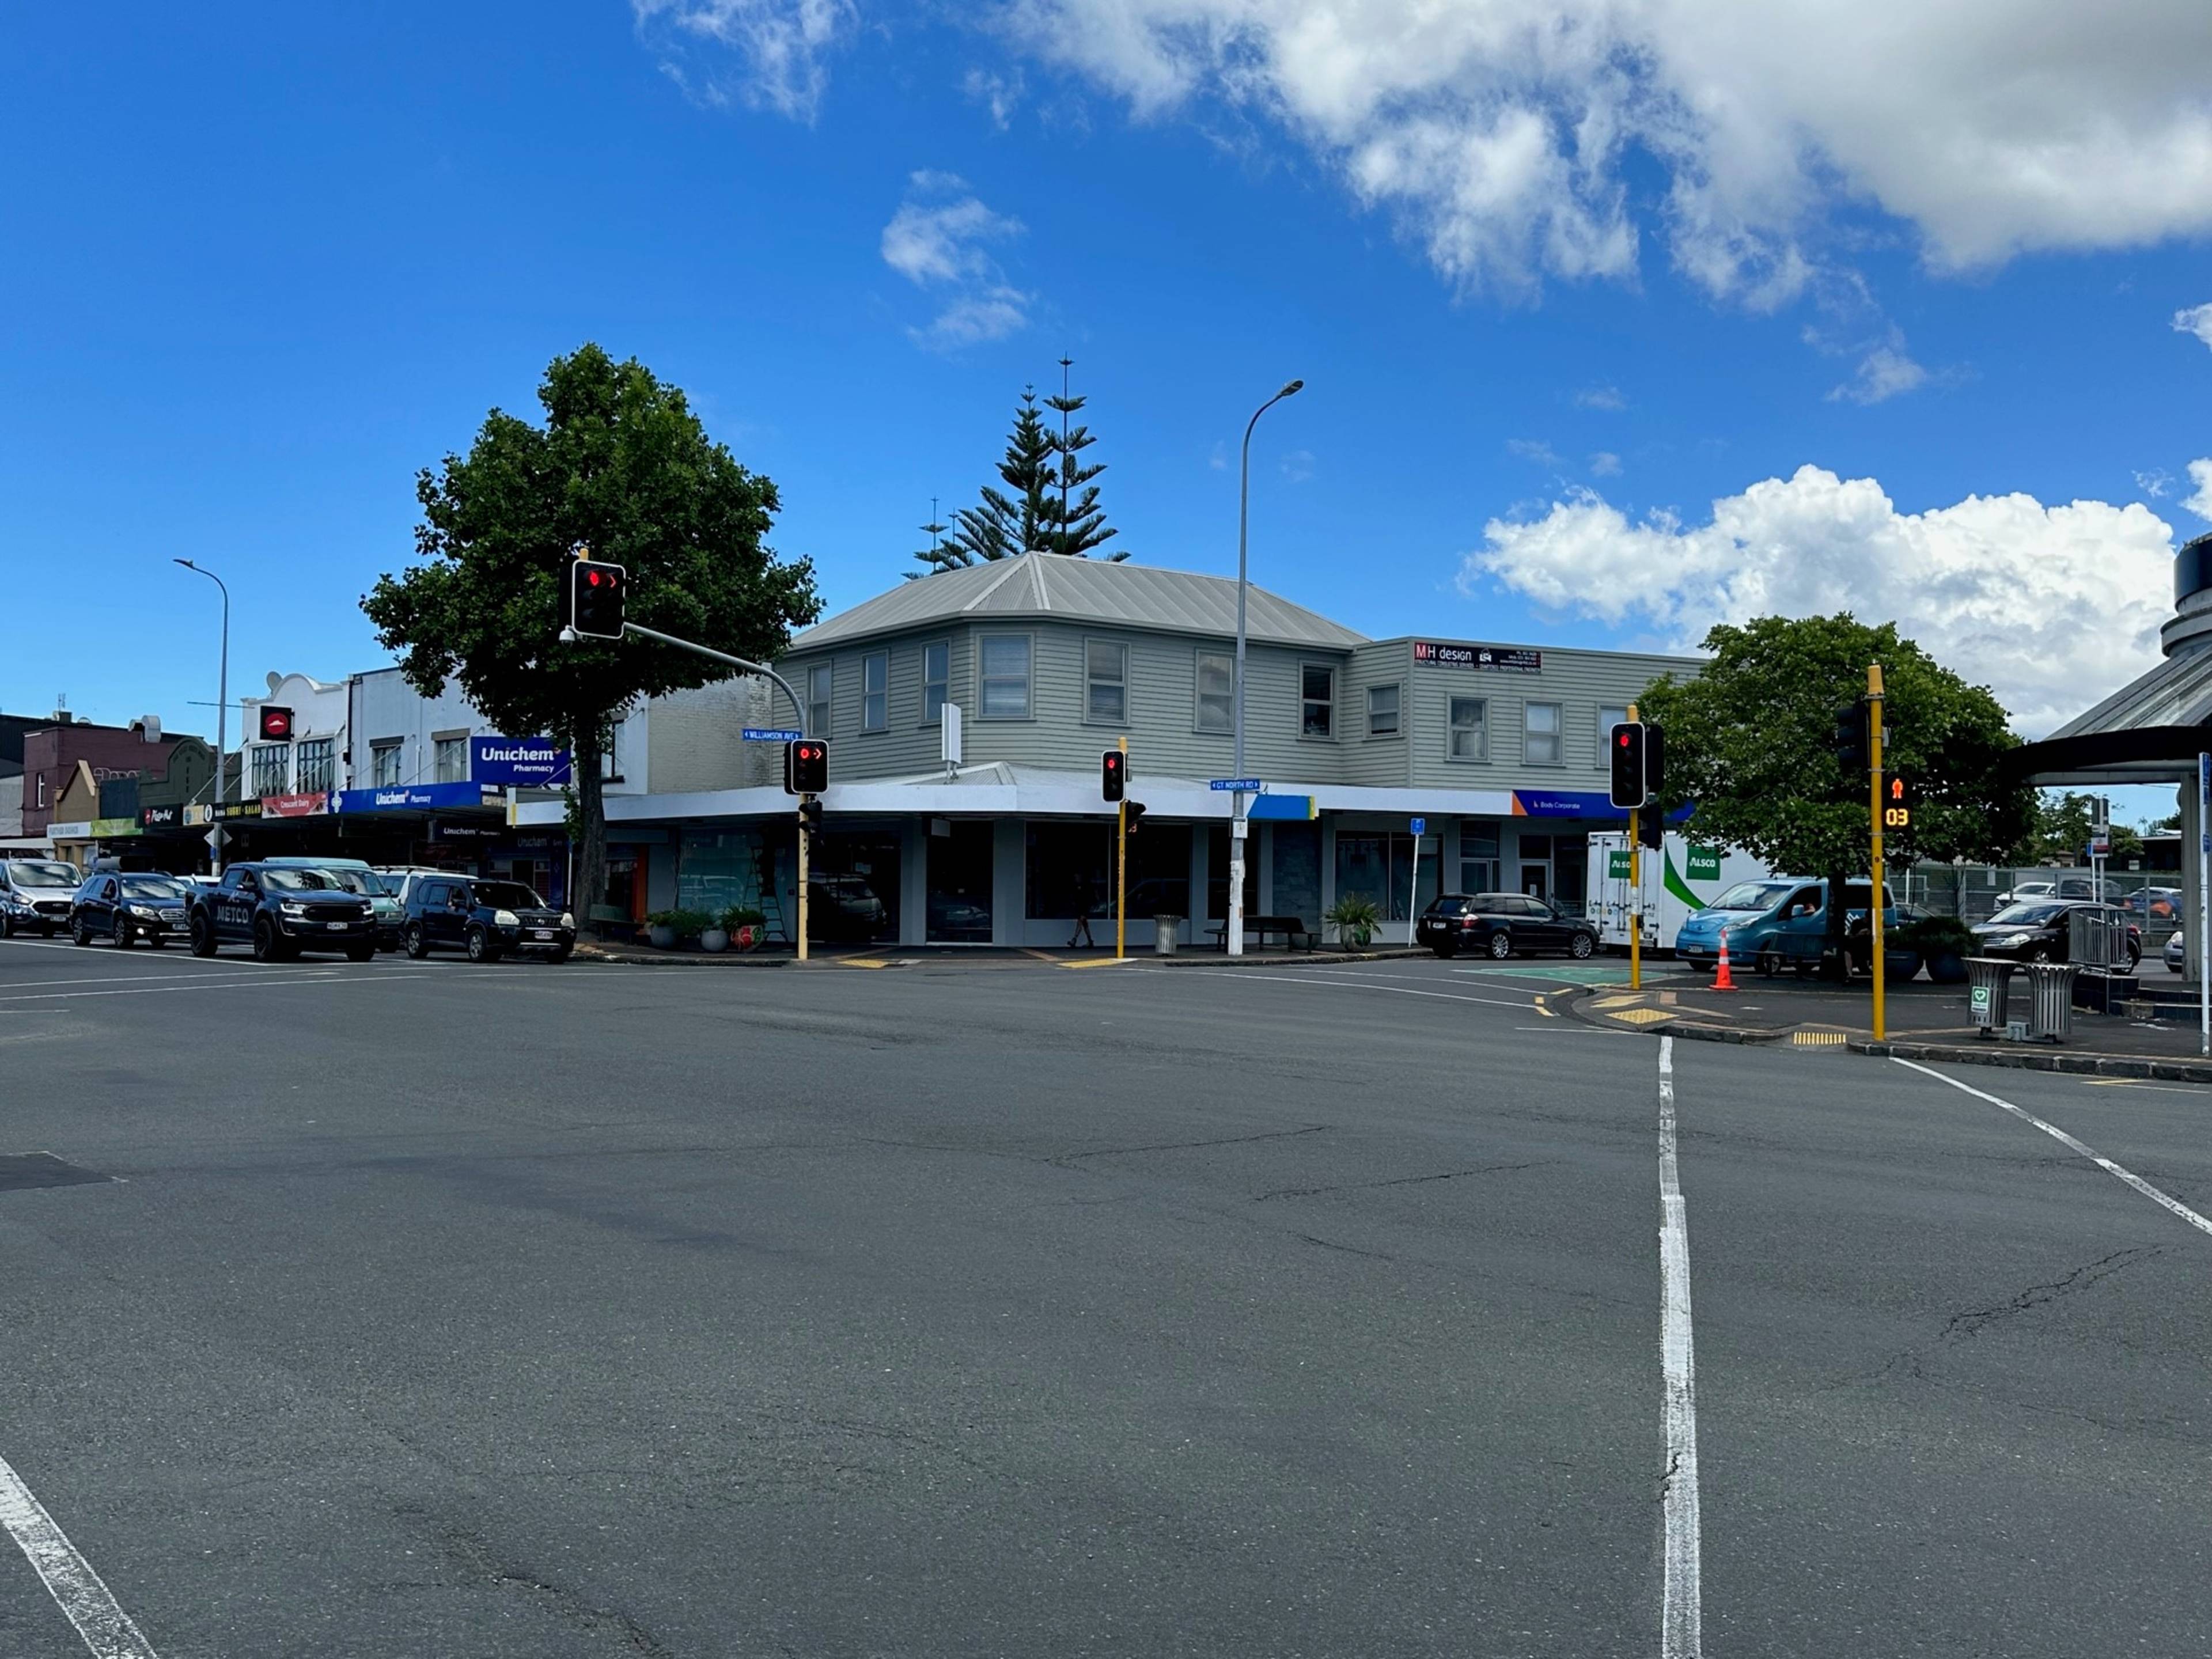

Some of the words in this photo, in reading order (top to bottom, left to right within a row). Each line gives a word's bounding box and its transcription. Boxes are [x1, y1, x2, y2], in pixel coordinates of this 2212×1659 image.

[1439, 646, 1472, 661] design
[749, 730, 783, 740] WILLIAMSON
[784, 732, 794, 740] AVE
[481, 747, 554, 761] Unichem
[513, 764, 554, 774] Pharmacy
[376, 791, 406, 805] Unichem
[410, 795, 431, 805] Pharmacy
[1540, 801, 1554, 810] Body
[1555, 801, 1581, 809] Corporate
[1885, 808, 1908, 825] 03
[1690, 857, 1716, 868] ALSCO
[217, 905, 249, 924] METCO
